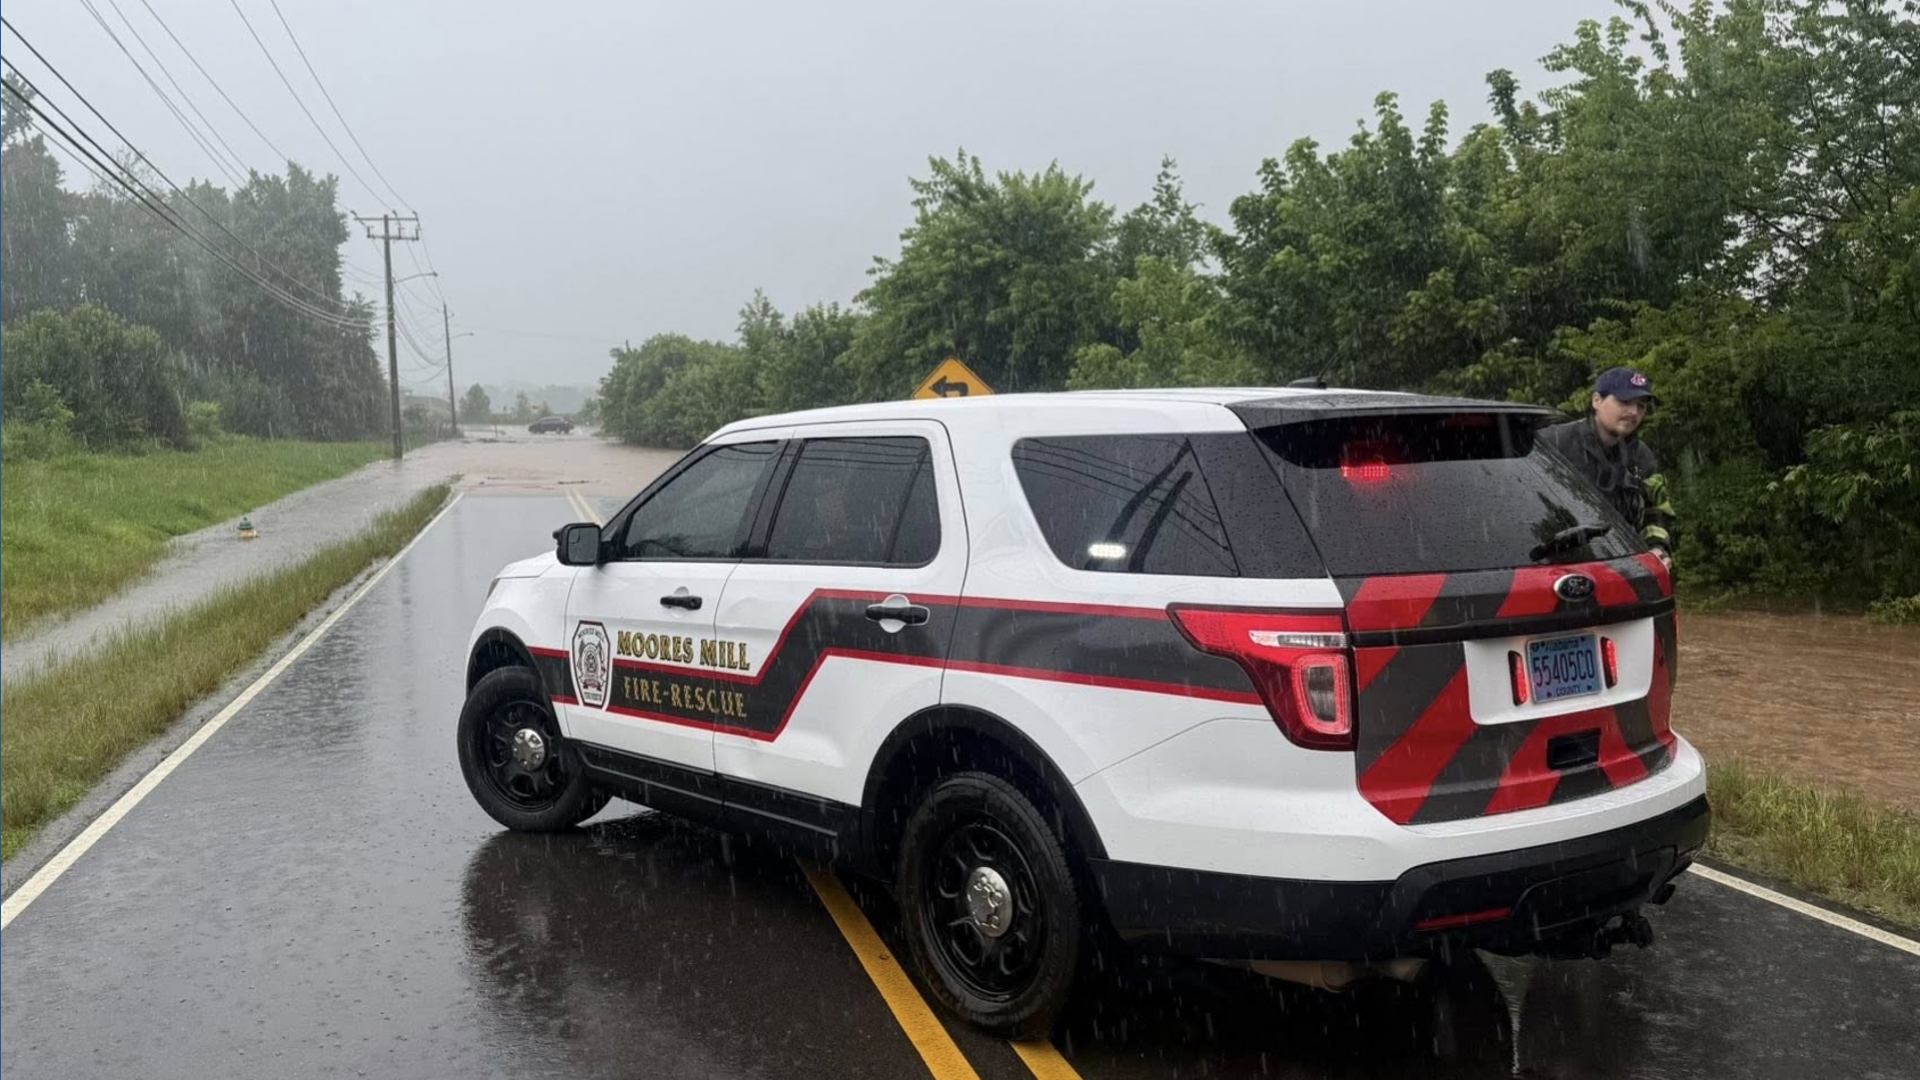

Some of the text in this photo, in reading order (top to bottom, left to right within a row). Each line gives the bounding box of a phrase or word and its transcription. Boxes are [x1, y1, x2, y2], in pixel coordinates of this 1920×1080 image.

[1566, 578, 1591, 595] Ford
[616, 630, 751, 671] MOORES MILL
[1545, 639, 1580, 652] Alabama
[624, 676, 748, 718] FIRE-RESCUE
[1556, 684, 1582, 697] COUNTY
